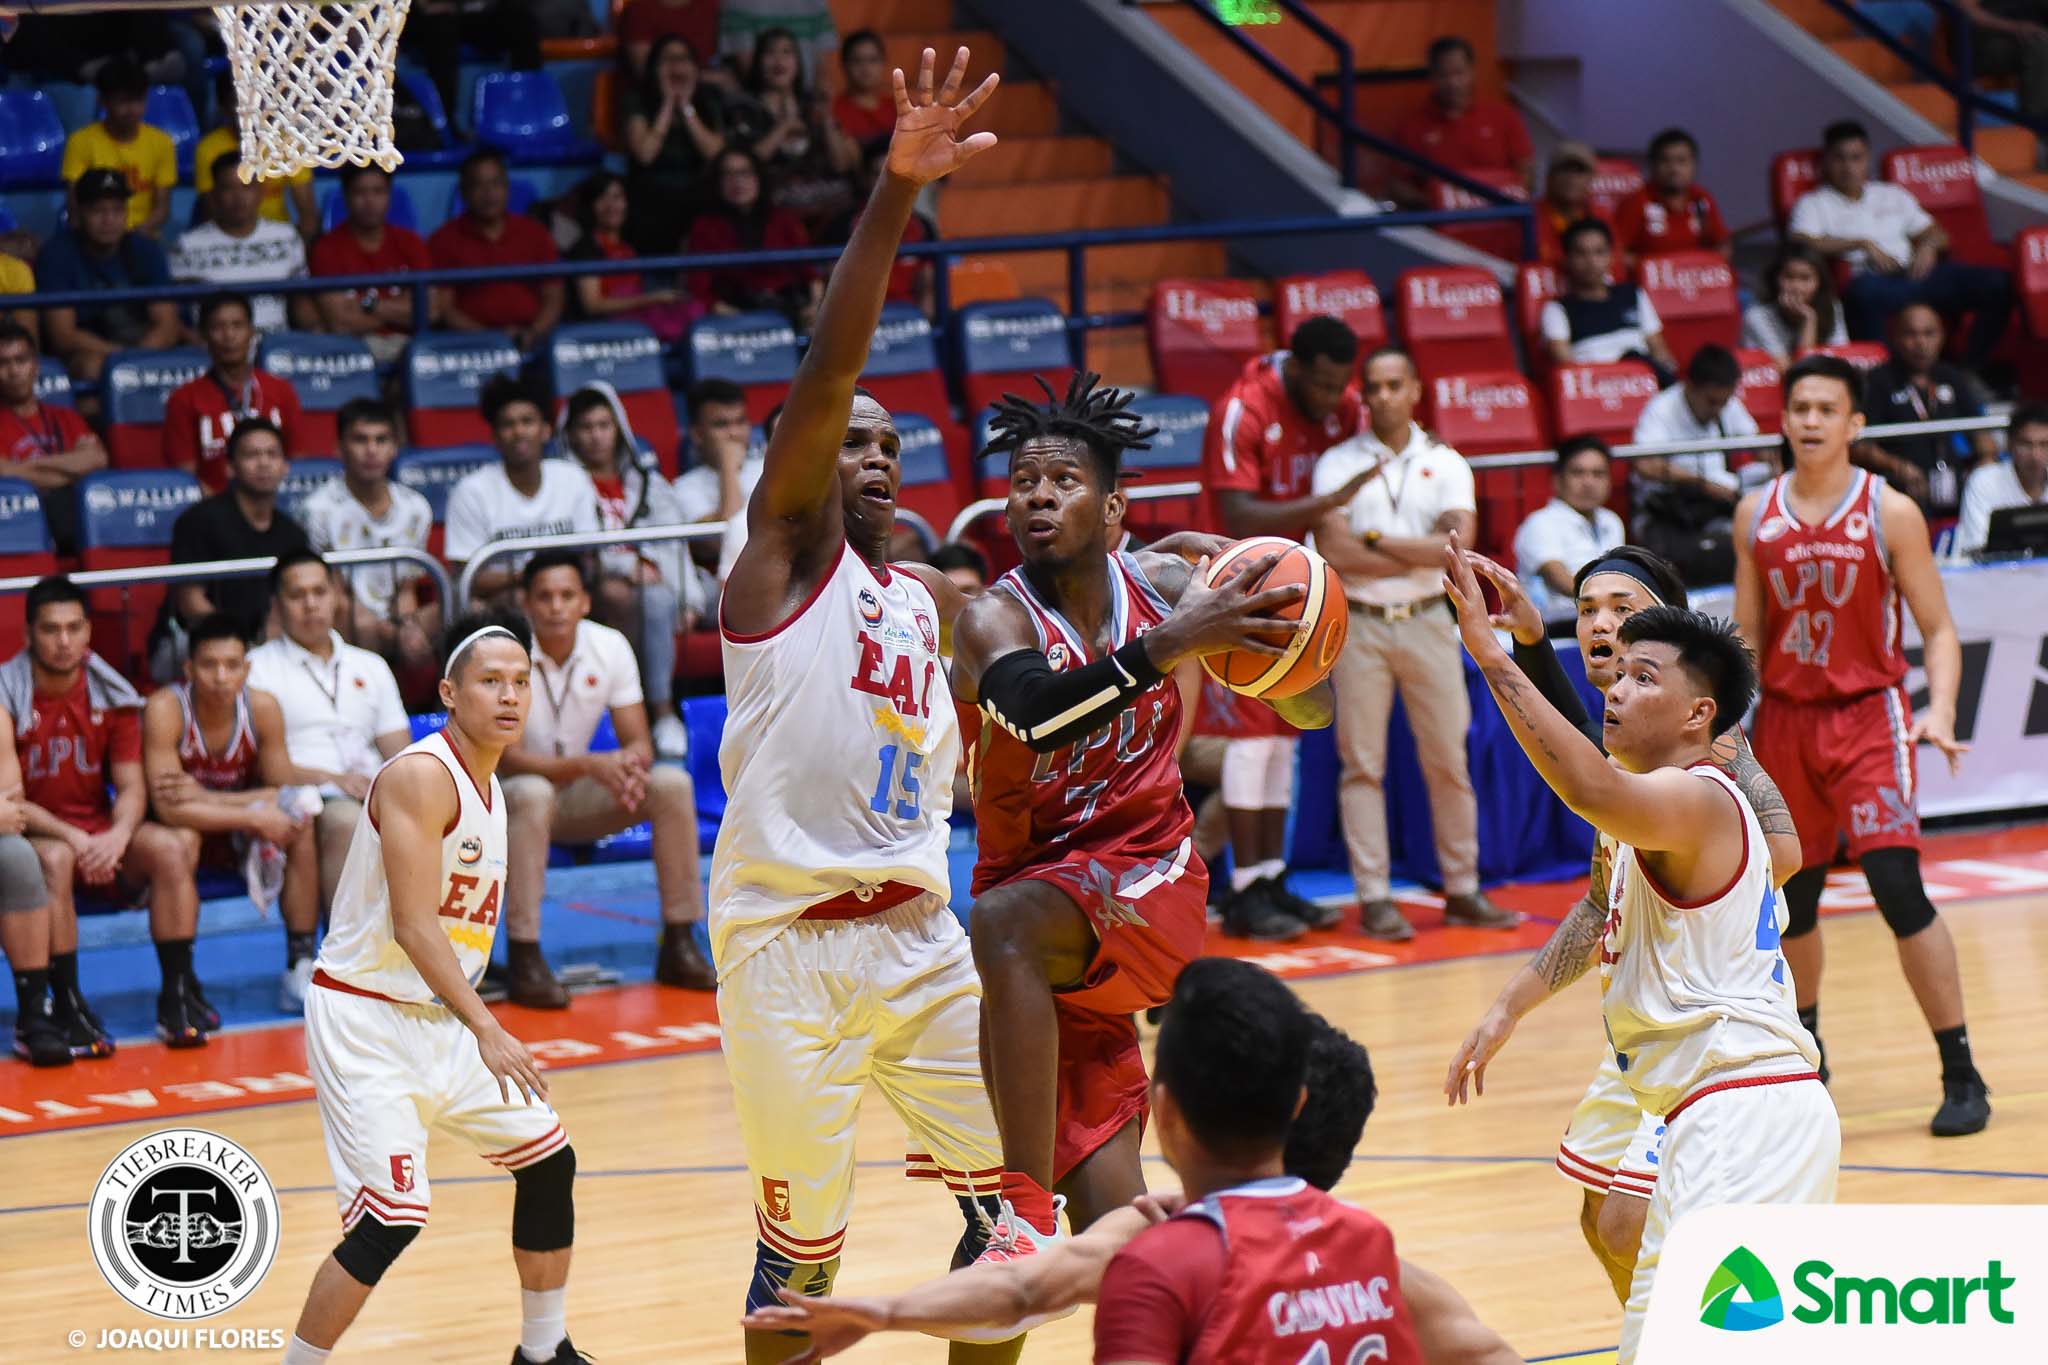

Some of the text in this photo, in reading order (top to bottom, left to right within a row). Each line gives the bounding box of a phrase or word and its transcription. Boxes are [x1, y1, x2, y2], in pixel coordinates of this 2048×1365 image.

[1768, 559, 1858, 610] LPU
[1780, 609, 1834, 667] 42
[870, 744, 924, 820] 15
[438, 872, 499, 926] EA
